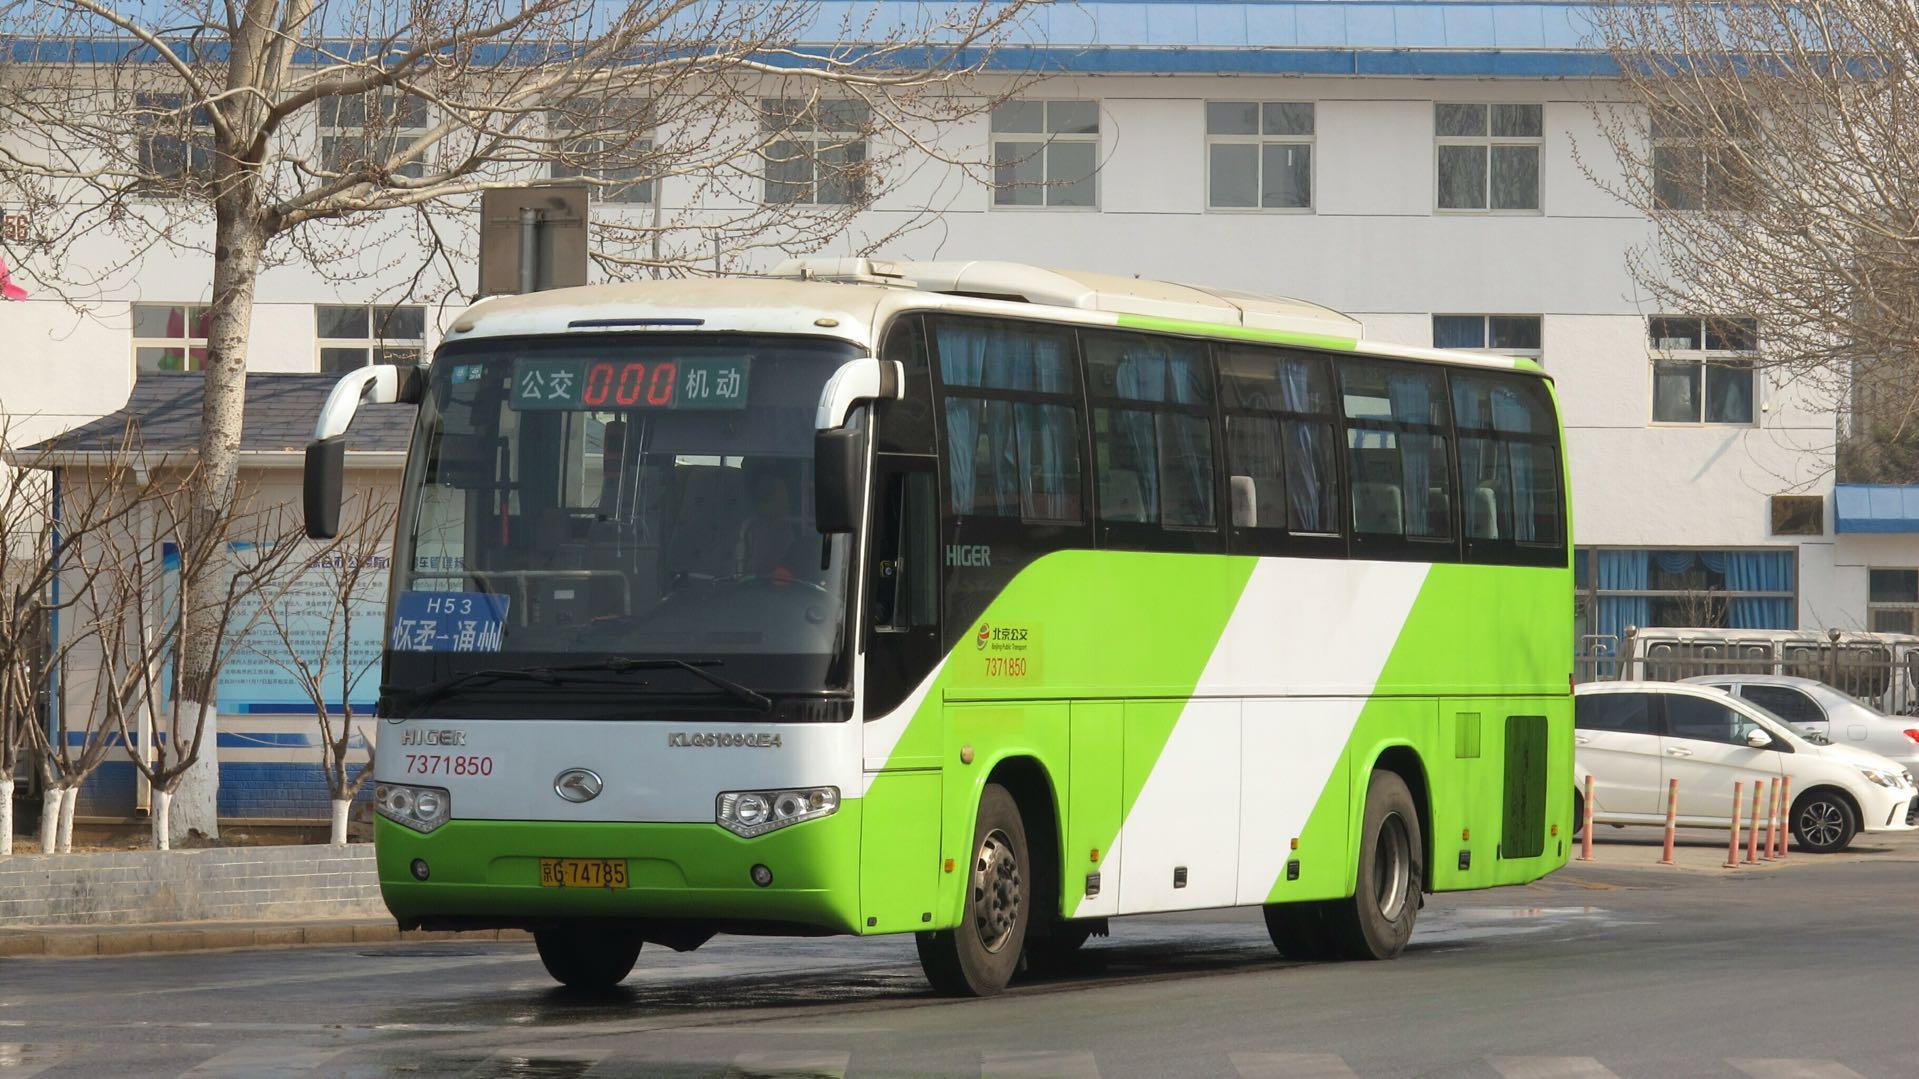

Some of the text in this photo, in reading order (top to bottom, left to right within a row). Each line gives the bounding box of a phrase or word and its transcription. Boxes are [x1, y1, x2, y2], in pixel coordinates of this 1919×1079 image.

[521, 363, 741, 405] 公交 000 机动
[946, 544, 991, 567] HIGER
[426, 597, 472, 614] H53
[992, 627, 1028, 641] 北京公交
[985, 657, 1027, 676] 7371850
[401, 729, 782, 748] HIGER KLQ6109QE4
[405, 754, 493, 776] 7371850
